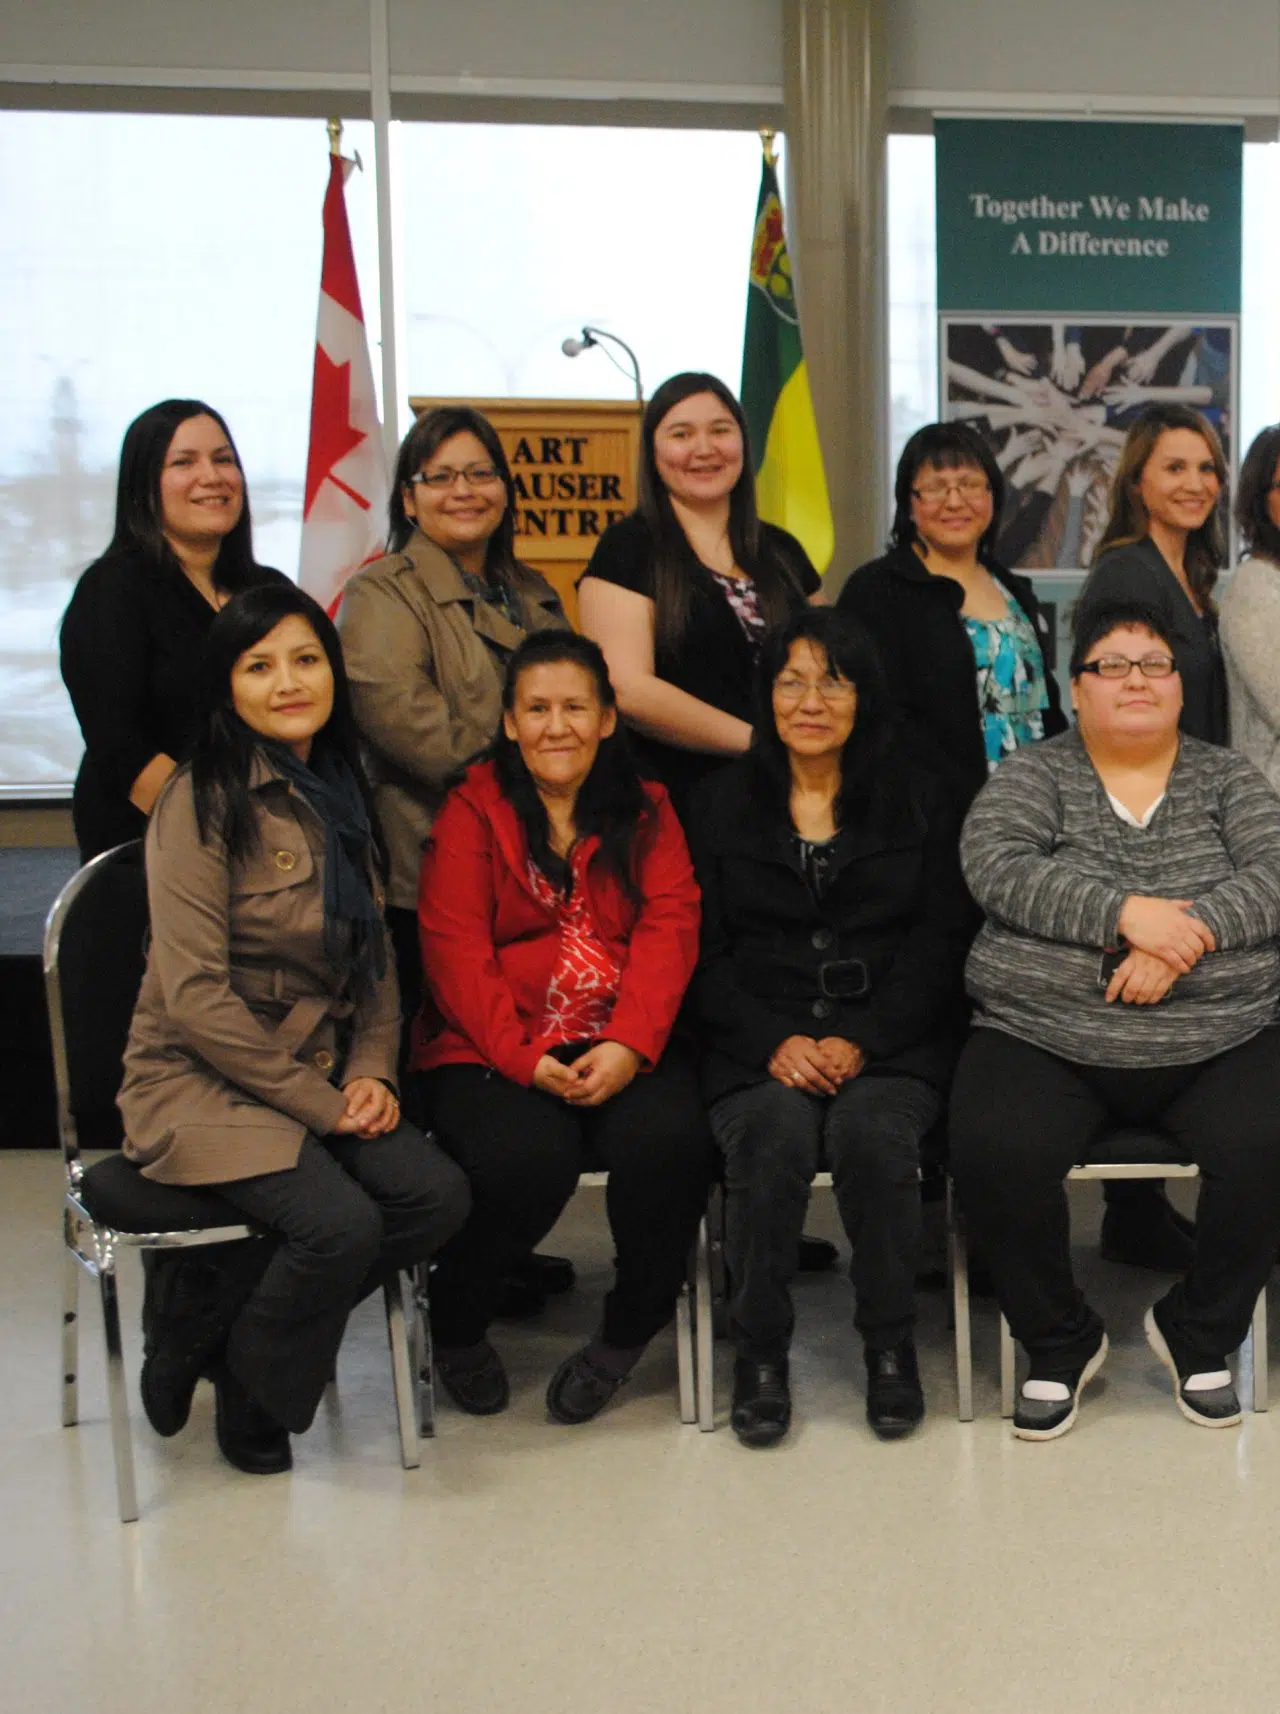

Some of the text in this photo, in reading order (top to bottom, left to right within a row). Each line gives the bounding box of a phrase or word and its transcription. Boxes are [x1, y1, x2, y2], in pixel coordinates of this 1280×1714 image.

[968, 193, 1210, 224] Together We Make
[1011, 230, 1169, 257] A Difference
[511, 437, 588, 465] ART
[512, 472, 624, 500] AUSER
[513, 508, 626, 535] ENTRE
